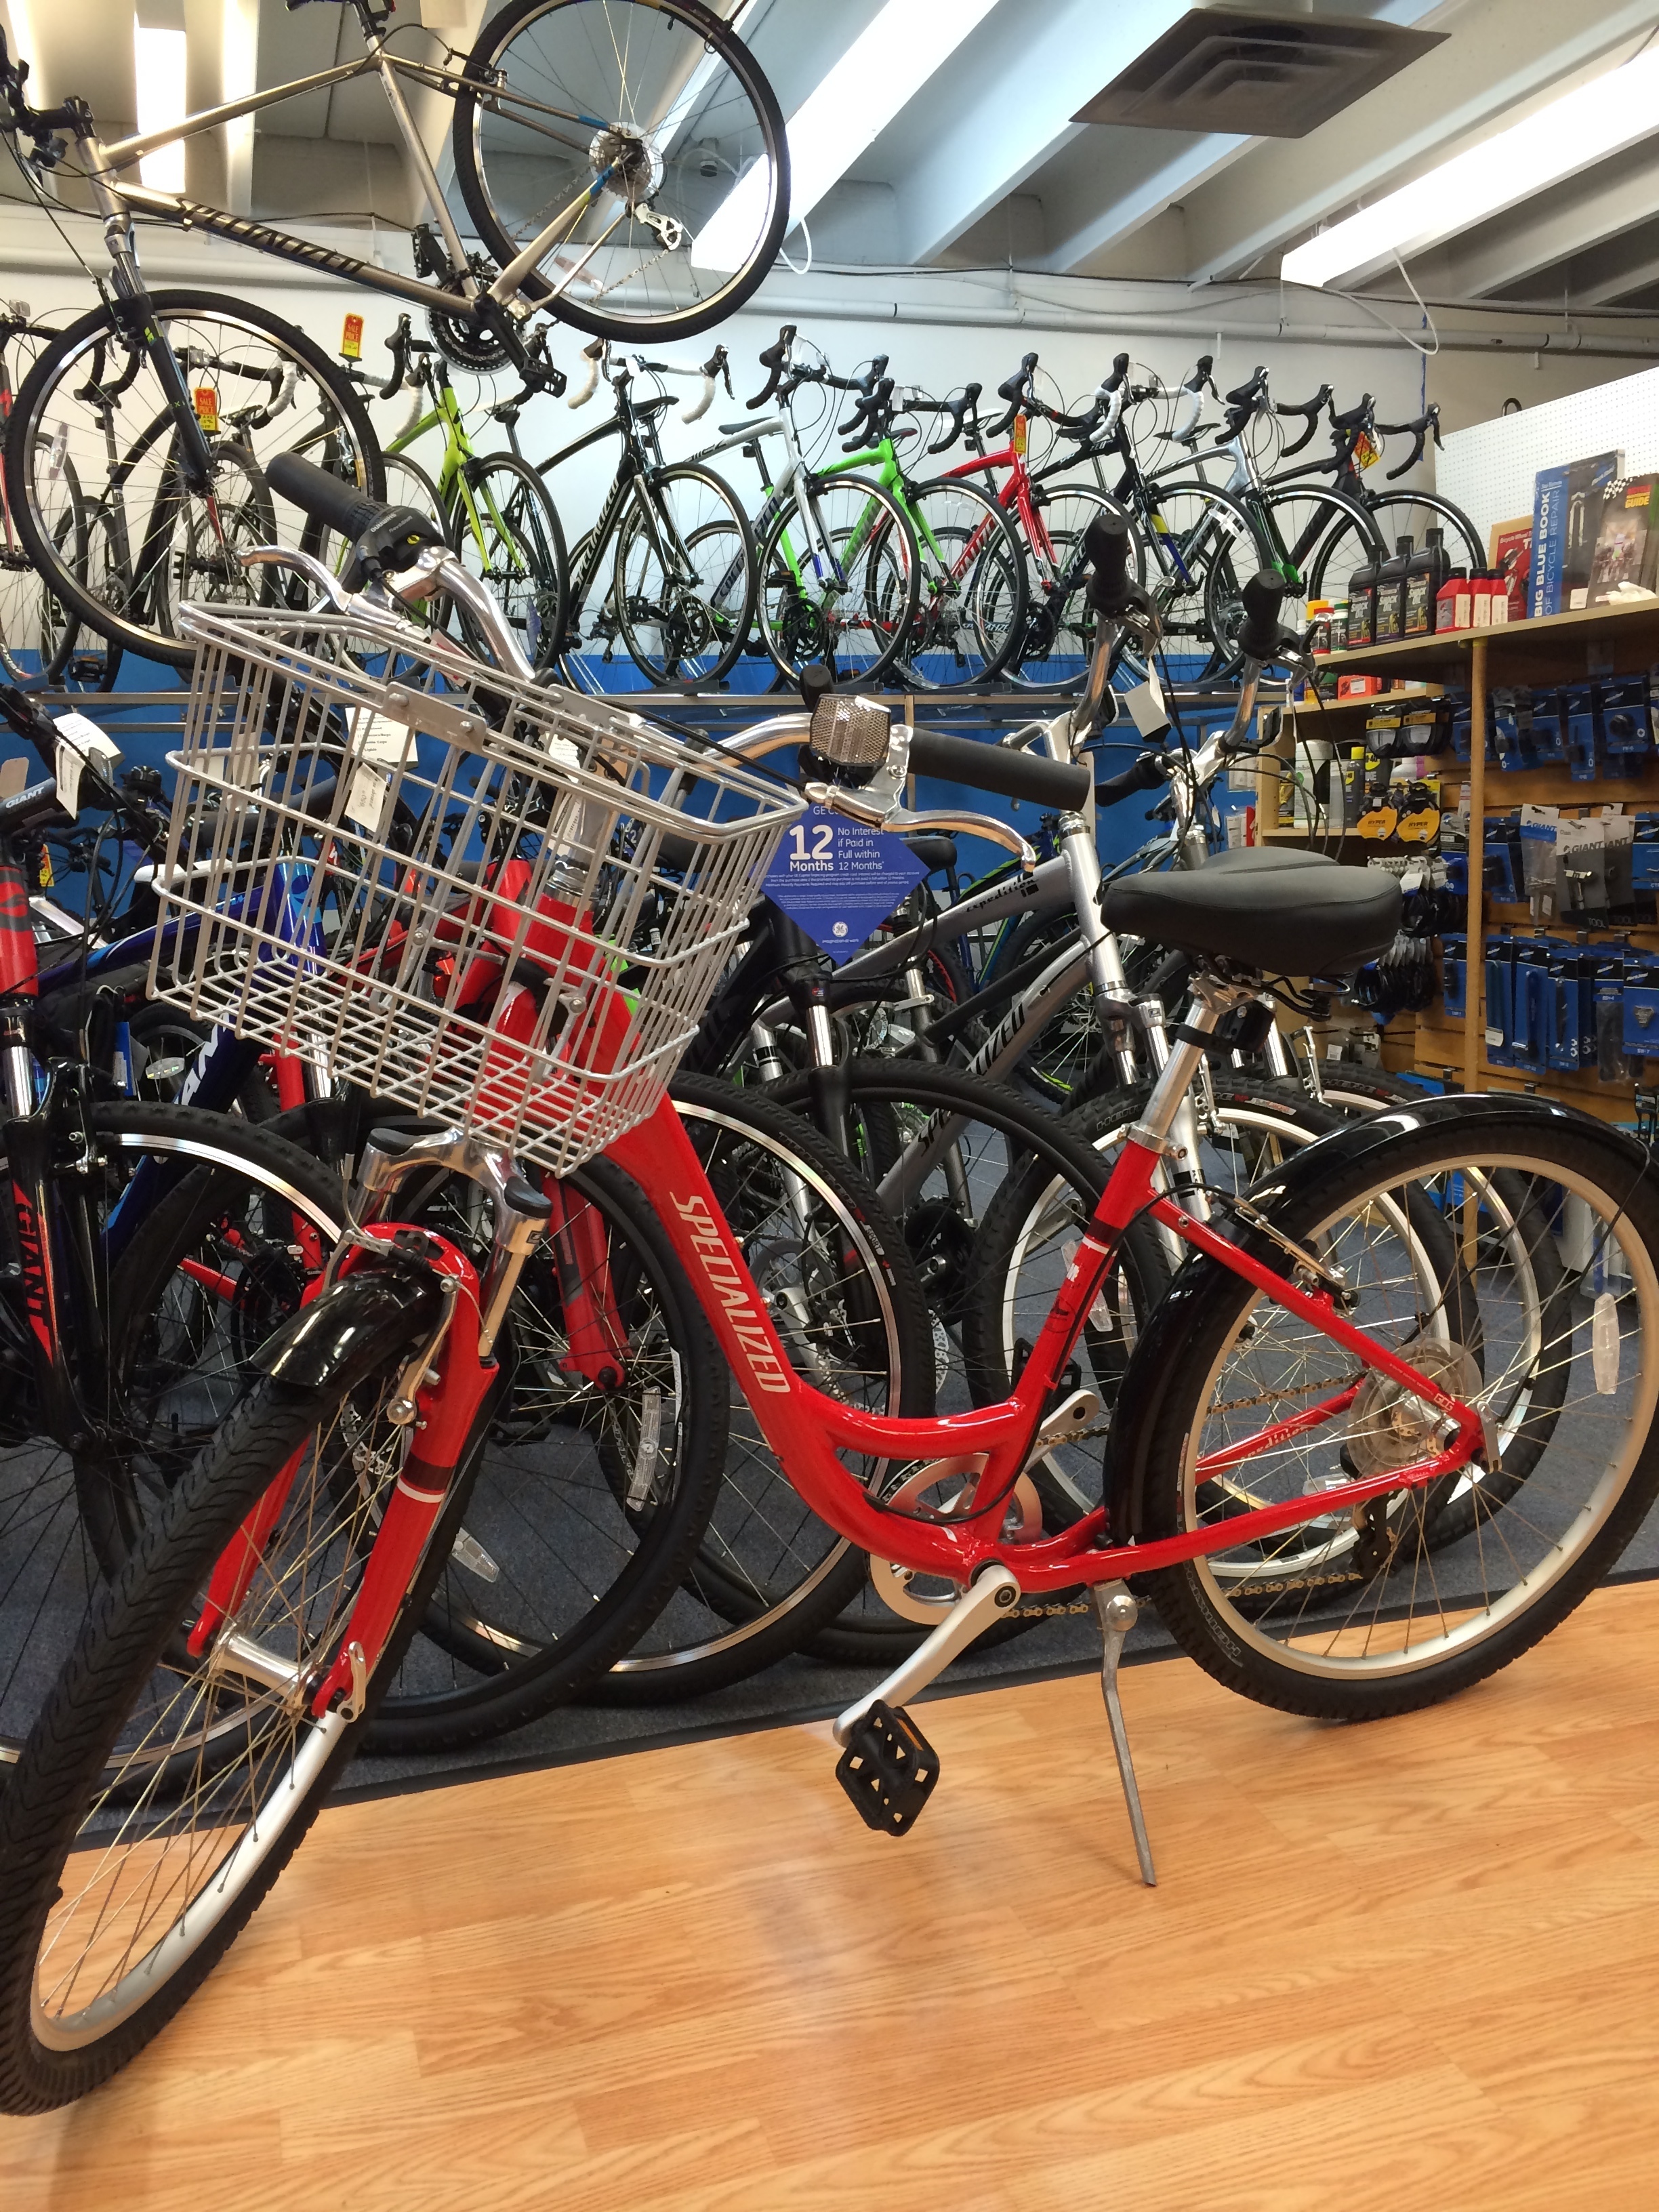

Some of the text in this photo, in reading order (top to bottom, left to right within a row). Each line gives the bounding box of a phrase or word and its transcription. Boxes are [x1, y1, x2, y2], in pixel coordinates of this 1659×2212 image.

[199, 397, 212, 406] SALE
[1625, 495, 1650, 508] GUIDE
[370, 513, 397, 533] SHIMANO
[575, 477, 619, 592] SPECIALIZED
[1534, 491, 1551, 617] BIG BLUE BOOK
[1544, 489, 1560, 615] OF BICYCLE REPAIR
[5, 786, 45, 809] GIANT
[813, 806, 825, 815] GE
[838, 827, 884, 836] No Interest
[1532, 822, 1557, 832] GIANT
[790, 824, 834, 860] 12
[838, 838, 874, 847] if Paid in
[1572, 840, 1604, 853] GIANT
[838, 849, 880, 859] Full within
[790, 860, 834, 872] Months
[838, 861, 849, 871] 12
[966, 879, 1040, 913] expedition
[1587, 917, 1607, 928] TOOL
[865, 1228, 882, 1250] SPORT
[670, 1191, 791, 1393] SPECIALIZED
